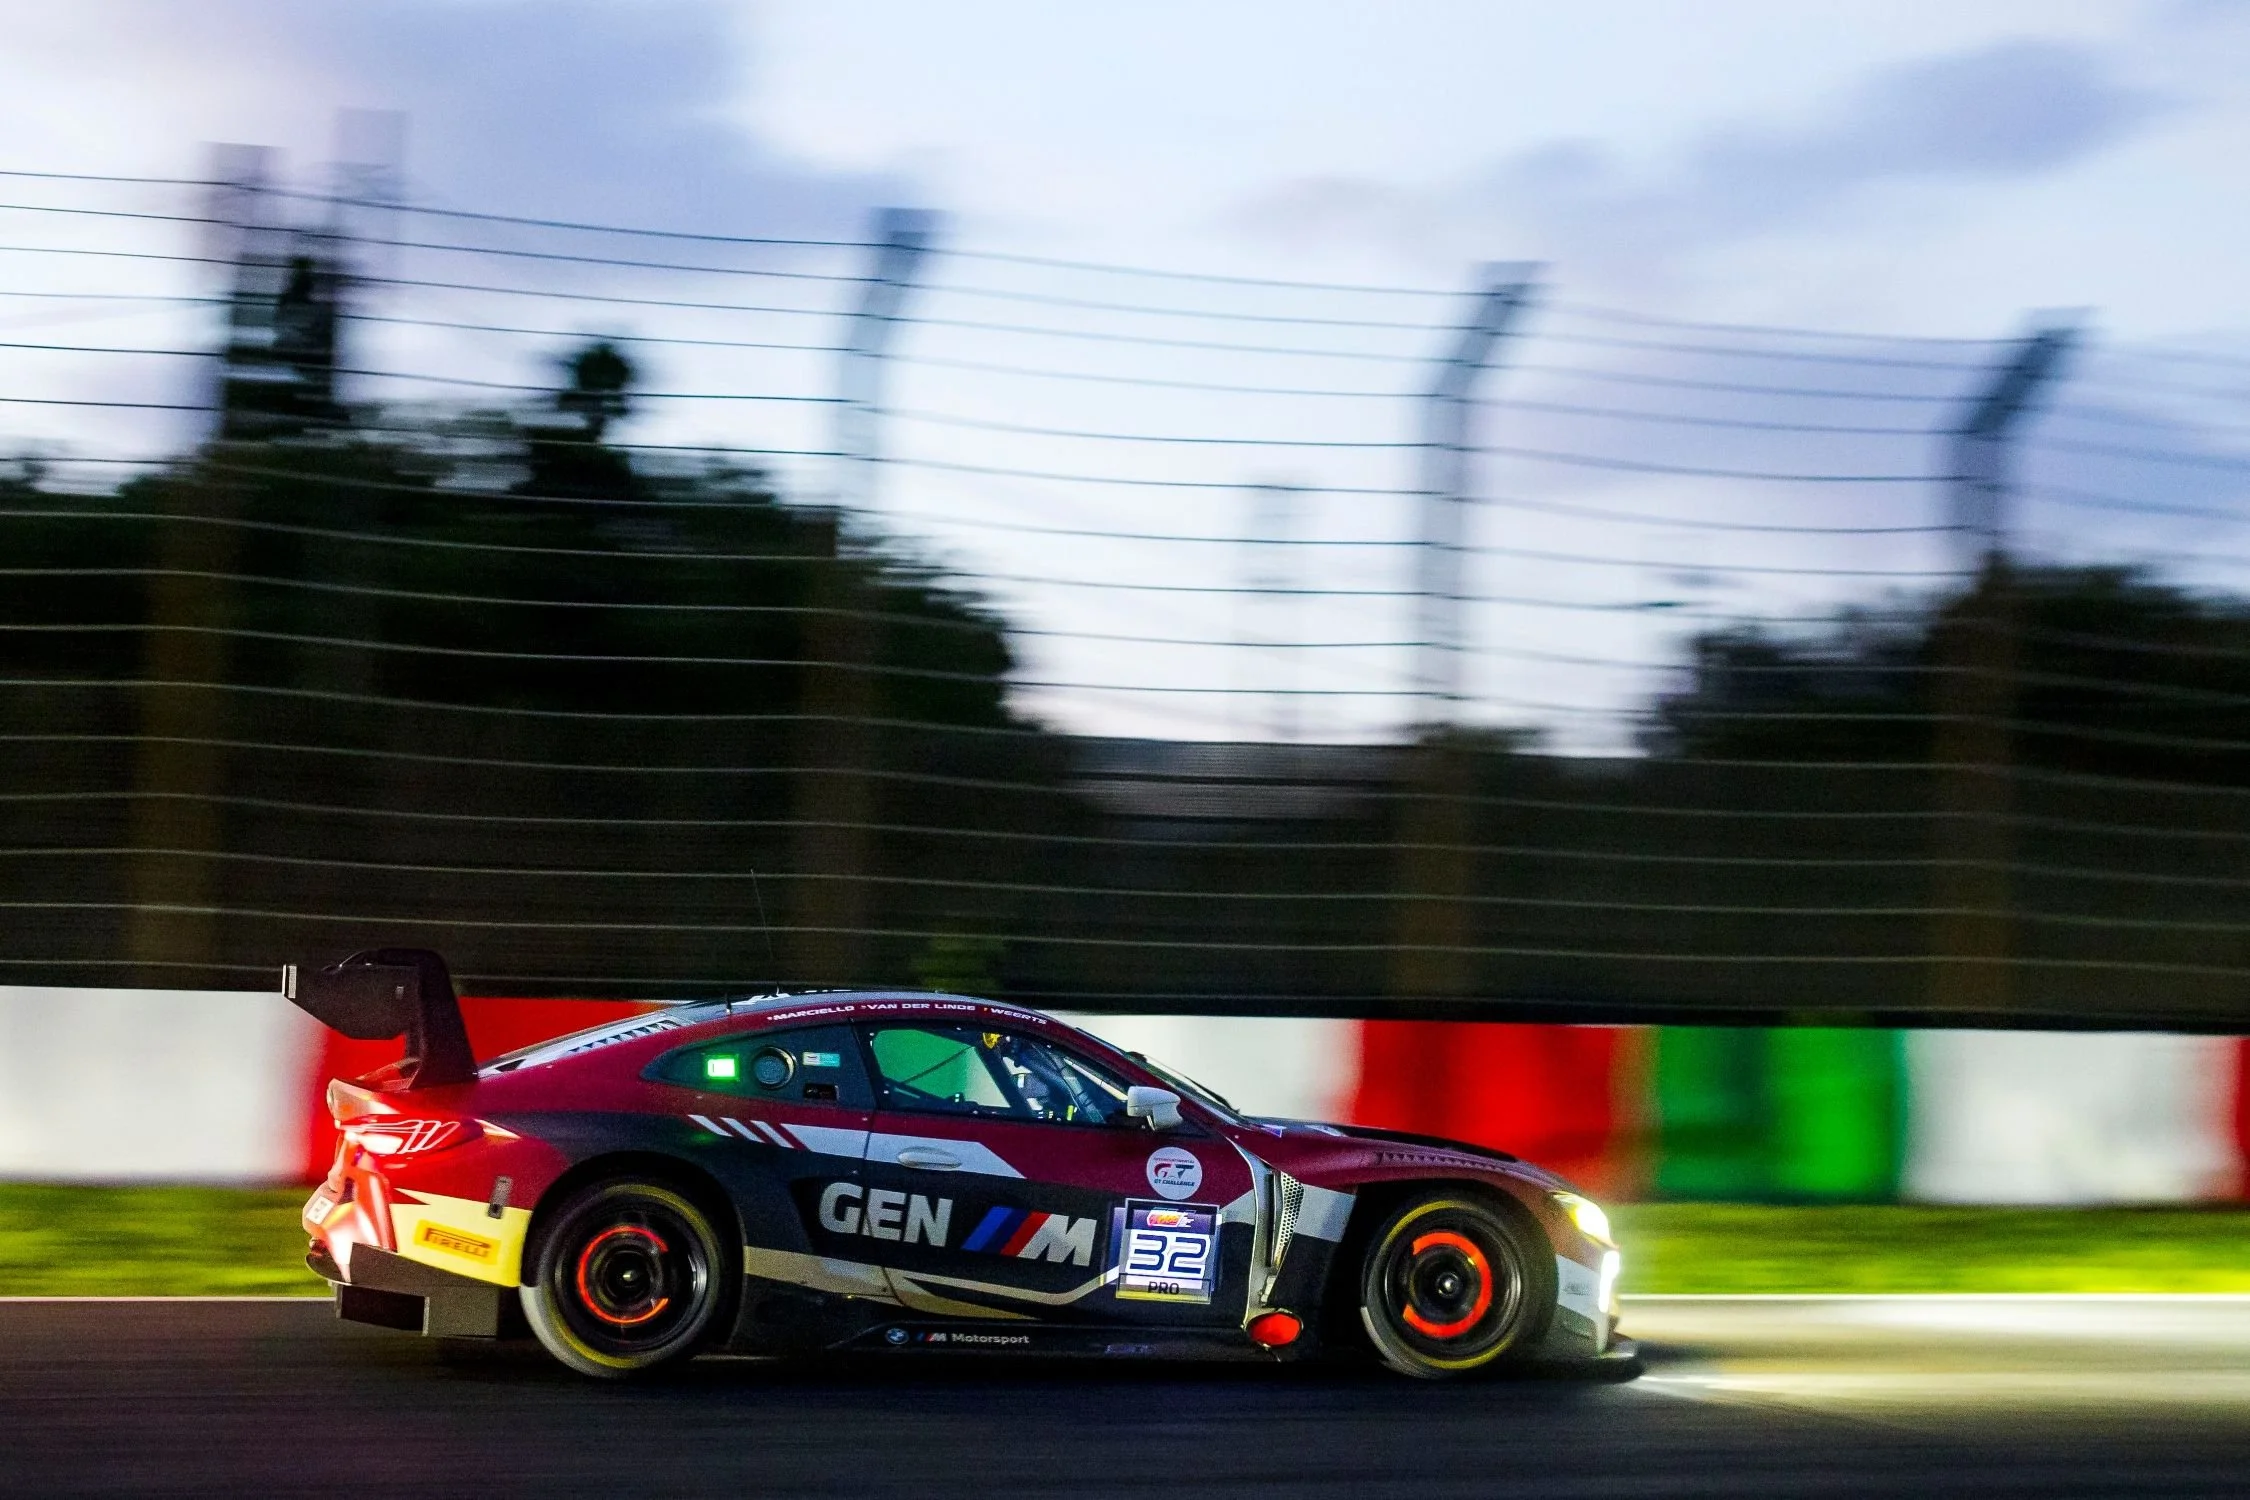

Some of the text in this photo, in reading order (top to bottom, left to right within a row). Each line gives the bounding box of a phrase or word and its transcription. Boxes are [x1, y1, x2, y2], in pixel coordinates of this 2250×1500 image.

[773, 1005, 855, 1020] MARCIELLO
[934, 1003, 976, 1011] LINDE
[990, 1007, 1047, 1025] WEERTS
[1162, 1179, 1195, 1187] CHALLENGE
[818, 1182, 1098, 1267] GEN M
[423, 1227, 491, 1258] PIRELLI
[1129, 1233, 1207, 1275] 32
[1147, 1281, 1180, 1295] PRO
[951, 1333, 1030, 1345] Motorsport
